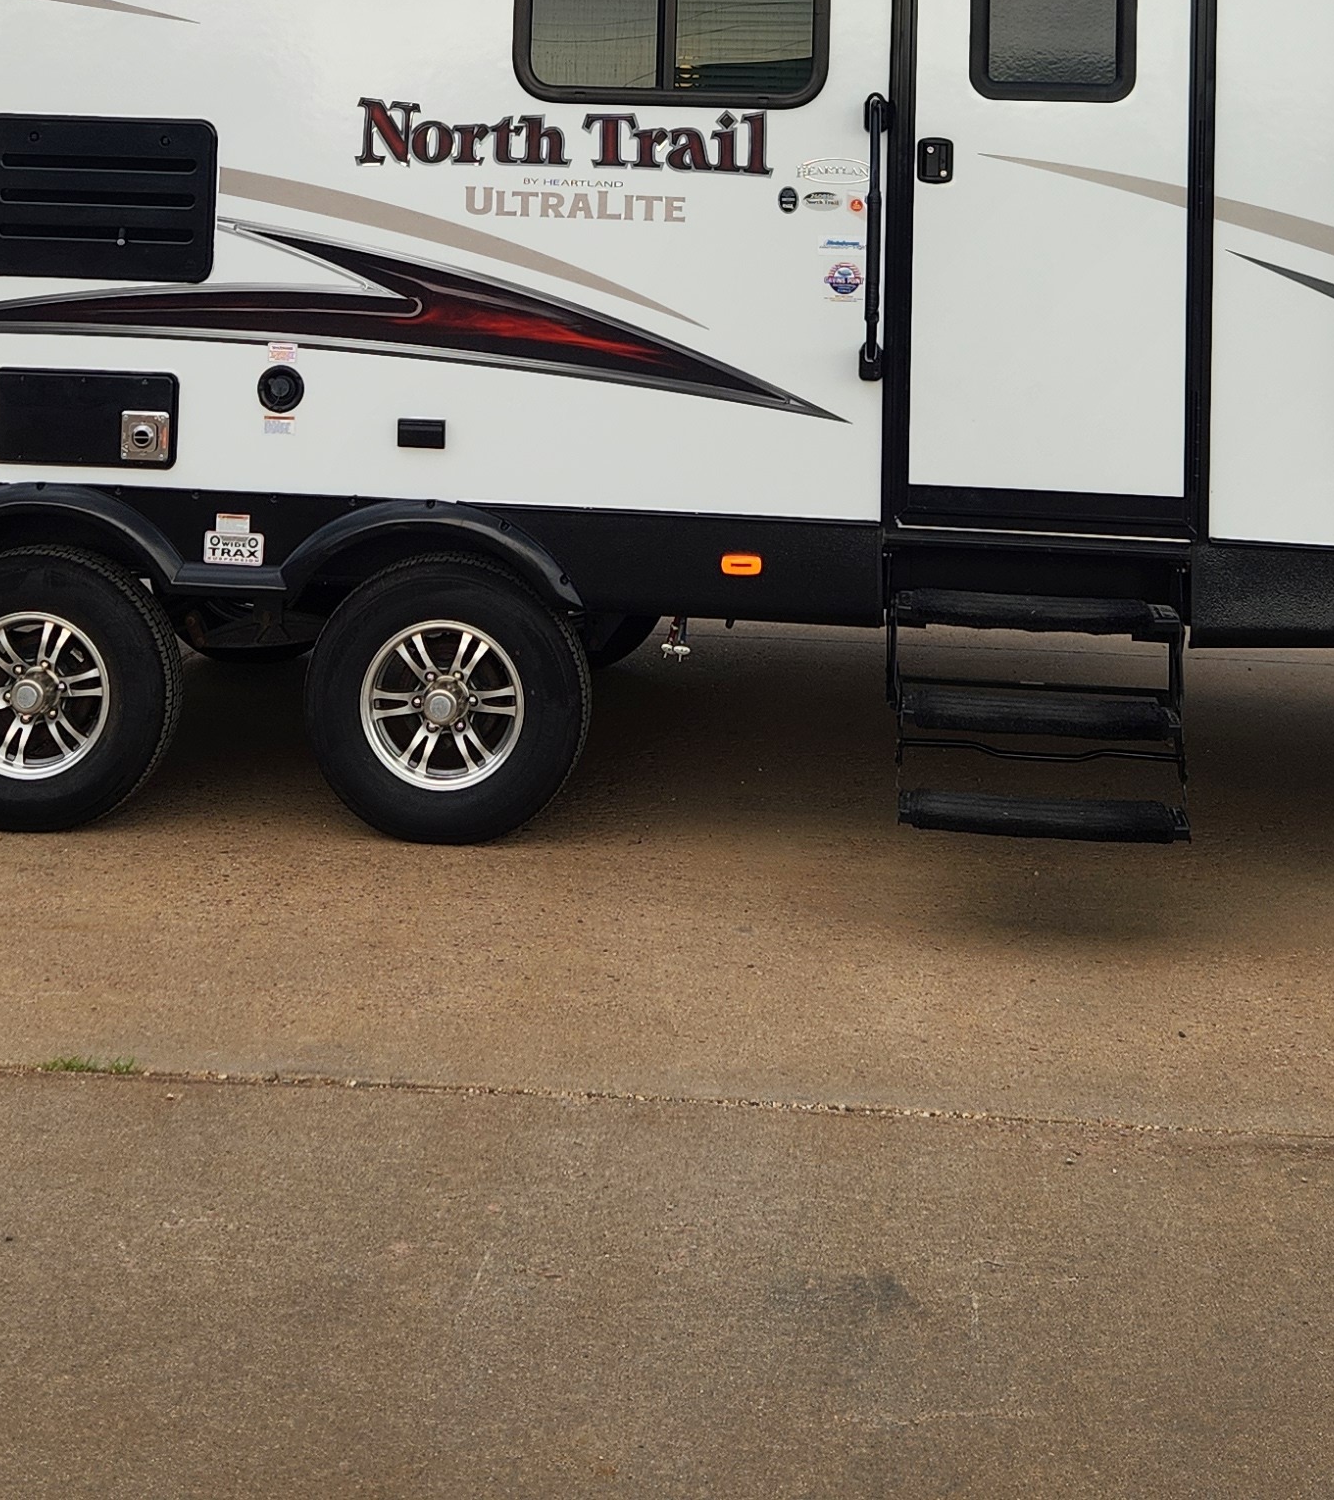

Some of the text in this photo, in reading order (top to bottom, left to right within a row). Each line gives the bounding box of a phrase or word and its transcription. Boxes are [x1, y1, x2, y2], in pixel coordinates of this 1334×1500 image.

[355, 97, 774, 178] North Trail
[796, 164, 869, 178] HEARTLAN
[523, 177, 624, 188] BY HEARTLAND
[208, 547, 259, 559] TRAX
